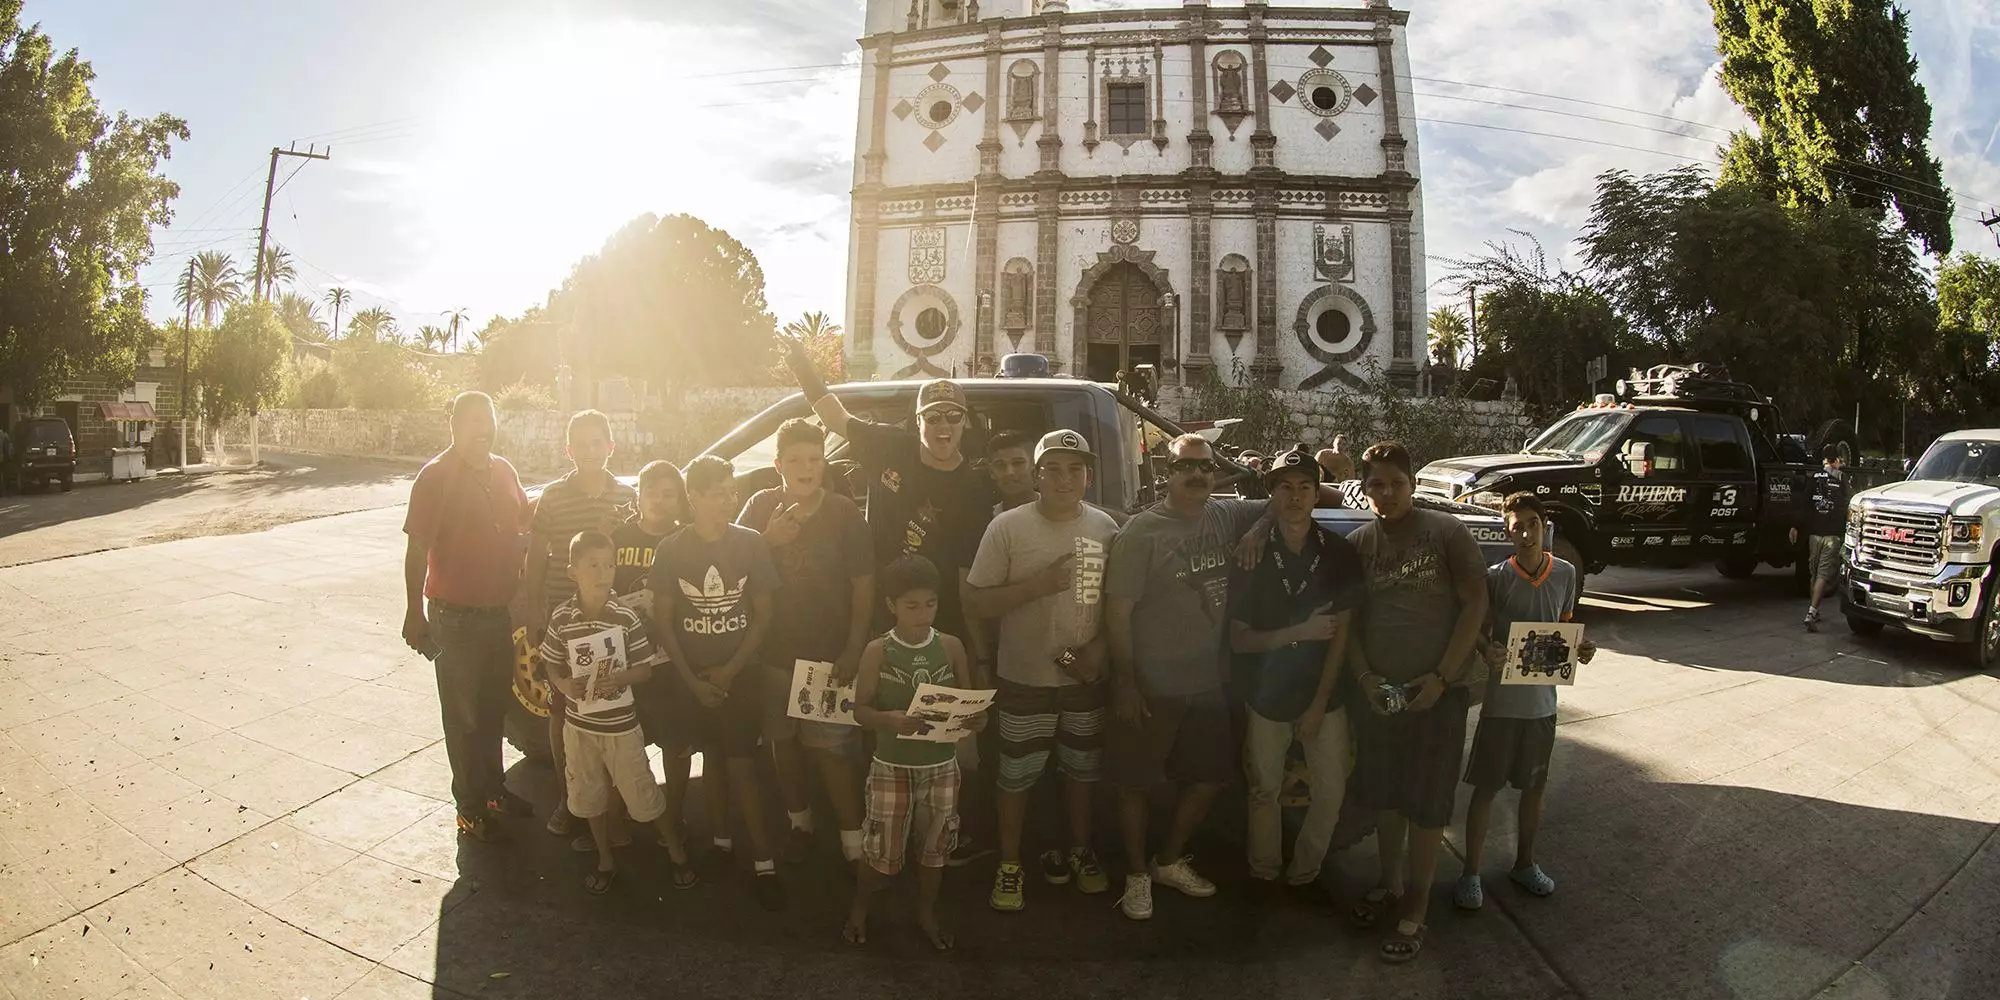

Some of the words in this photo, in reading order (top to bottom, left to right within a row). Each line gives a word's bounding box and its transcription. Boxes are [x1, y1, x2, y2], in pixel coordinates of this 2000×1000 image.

[1536, 485, 1550, 494] Go
[1560, 484, 1578, 494] rich
[1616, 485, 1686, 502] RIVIERA
[1769, 484, 1791, 492] ULTRA
[1722, 489, 1737, 506] 3
[1710, 508, 1738, 517] POST
[1881, 527, 1915, 543] GMC
[1075, 536, 1083, 561] COAST
[1081, 536, 1105, 605] AERO
[683, 614, 747, 634] adidas
